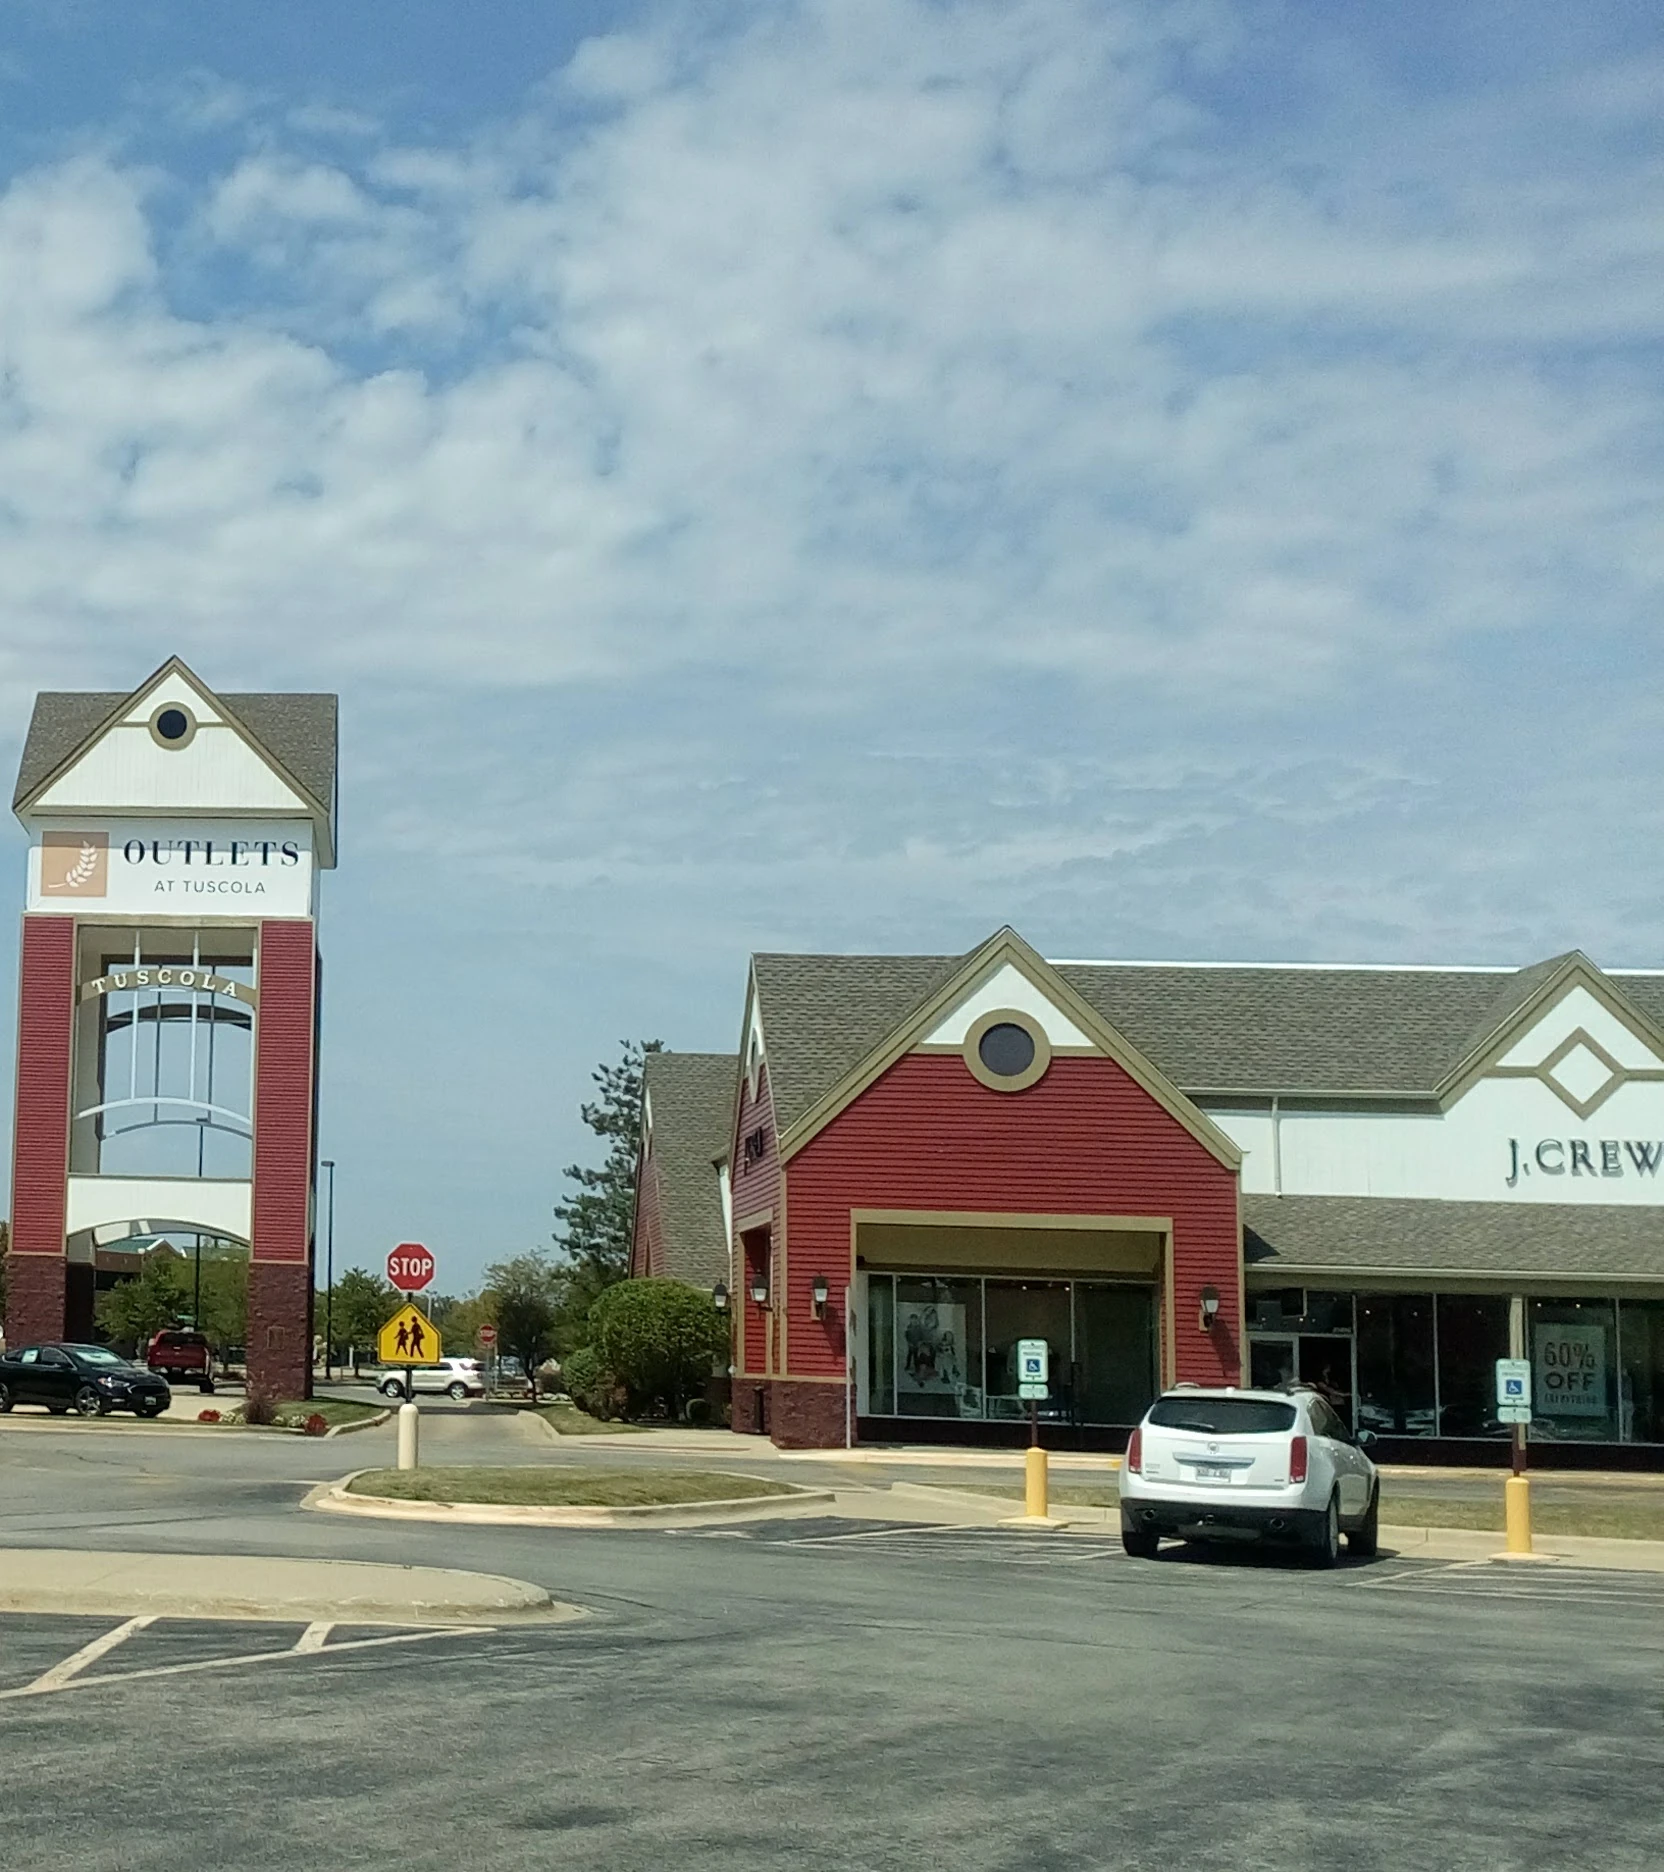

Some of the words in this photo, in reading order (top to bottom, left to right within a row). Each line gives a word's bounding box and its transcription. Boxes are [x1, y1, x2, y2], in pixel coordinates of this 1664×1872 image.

[124, 839, 300, 867] OUTLETS
[154, 880, 175, 892] AT
[183, 880, 266, 894] TUSCOLA
[91, 969, 237, 998] TUSCOLA
[389, 1257, 432, 1276] STOP
[1544, 1342, 1595, 1369] 60%
[1544, 1371, 1596, 1391] OFF
